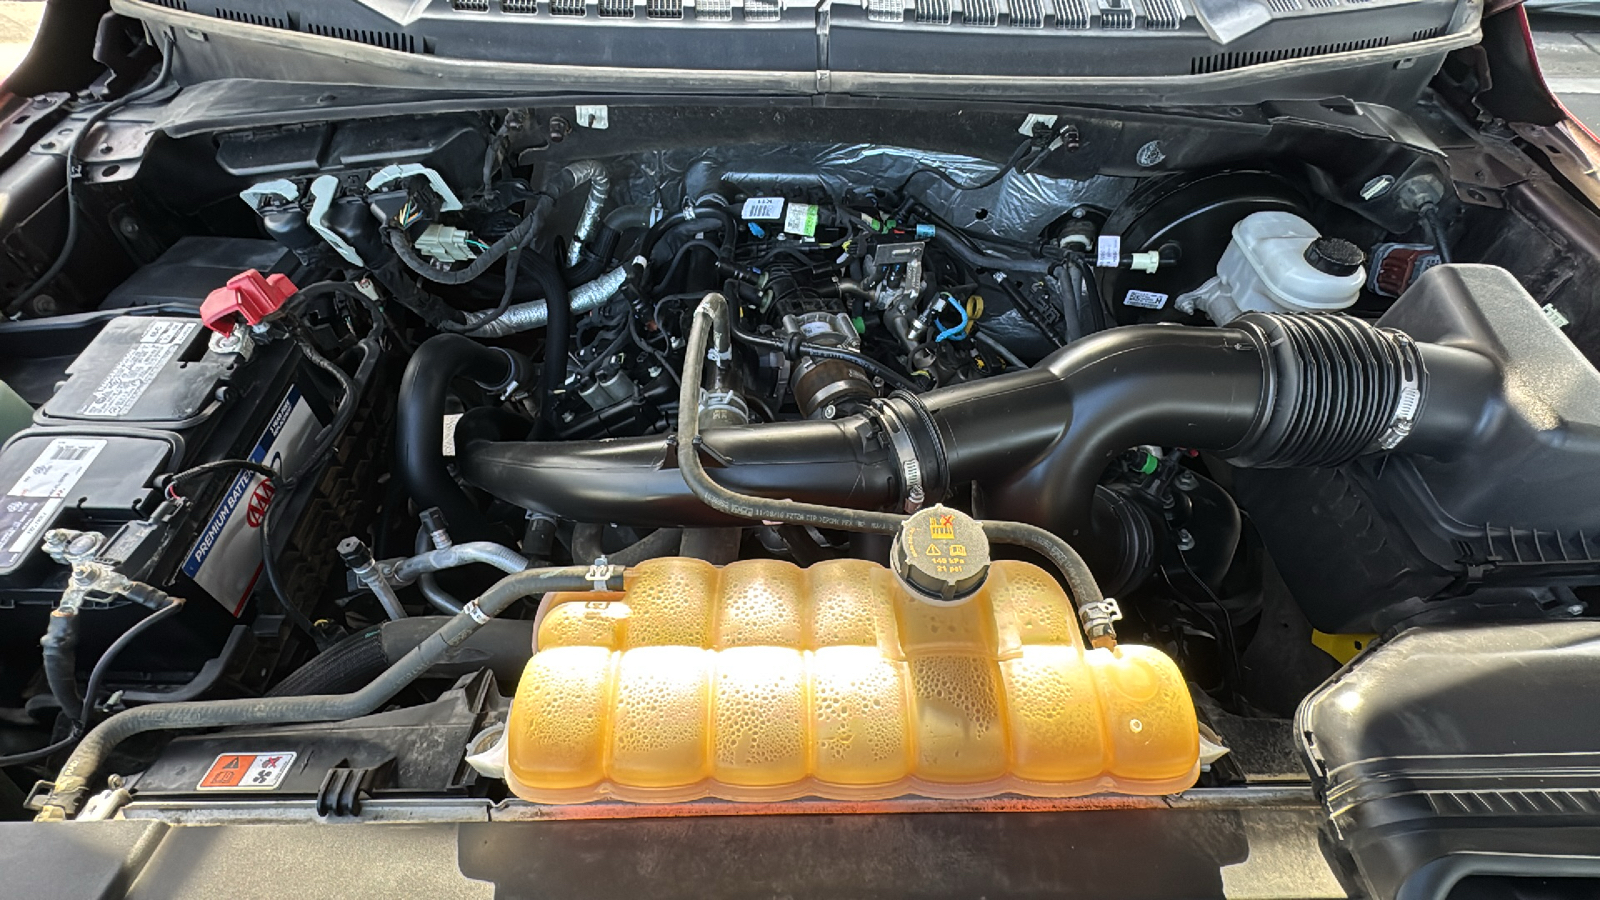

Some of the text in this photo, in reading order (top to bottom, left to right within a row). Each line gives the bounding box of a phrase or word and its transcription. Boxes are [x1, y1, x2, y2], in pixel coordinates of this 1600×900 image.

[249, 479, 275, 525] AAA
[194, 506, 230, 563] PREMIUM
[949, 565, 962, 573] psi
